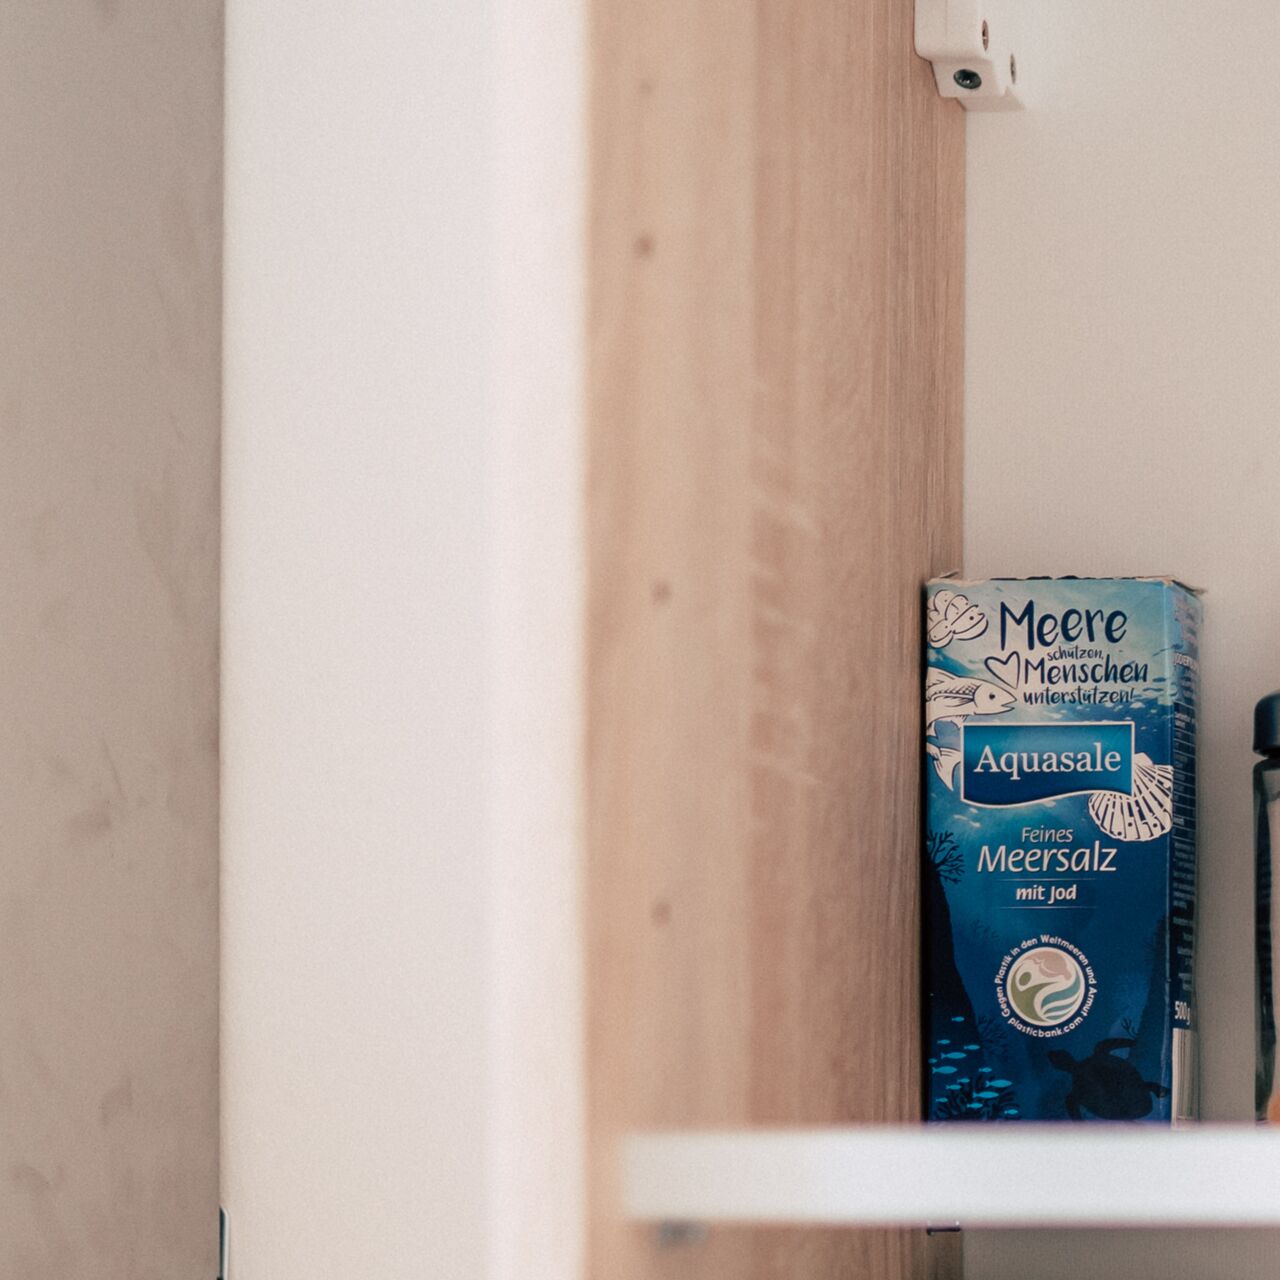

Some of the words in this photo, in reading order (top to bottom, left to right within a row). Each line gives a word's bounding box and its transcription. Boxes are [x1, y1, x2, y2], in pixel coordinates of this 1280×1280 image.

[999, 600, 1128, 651] Meere
[1047, 645, 1104, 661] schützen,
[1024, 654, 1148, 685] Menschen
[1023, 685, 1135, 705] unterstützen!
[973, 742, 1122, 781] Aquasale
[1021, 827, 1074, 843] Feines
[977, 841, 1118, 873] Meersalz
[1016, 885, 1045, 900] mit
[1047, 884, 1077, 904] Jod
[1010, 947, 1021, 957] in
[1021, 938, 1038, 949] den
[1040, 934, 1089, 966] Weltmeeren
[994, 954, 1013, 984] Plastik
[1085, 966, 1097, 985] und
[996, 986, 1011, 1017] Gegen
[1080, 986, 1098, 1017] Armut
[1008, 1016, 1084, 1038] plasticbank.com
